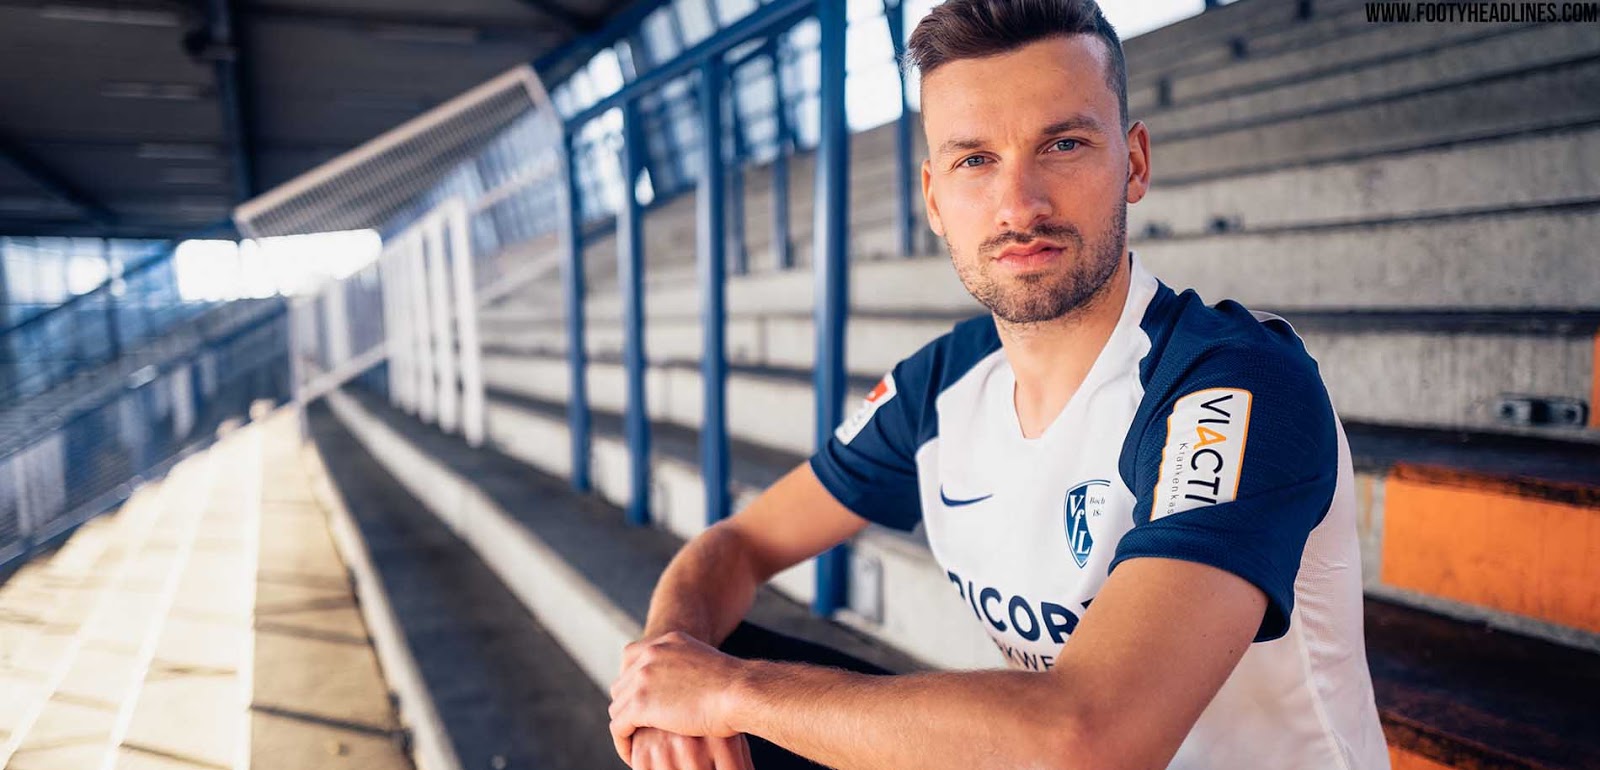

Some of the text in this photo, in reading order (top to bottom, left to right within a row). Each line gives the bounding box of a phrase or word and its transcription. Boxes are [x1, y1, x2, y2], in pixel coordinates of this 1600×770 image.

[1184, 394, 1234, 505] VIACTI
[1069, 494, 1091, 555] VfL
[947, 570, 1095, 644] ICOR
